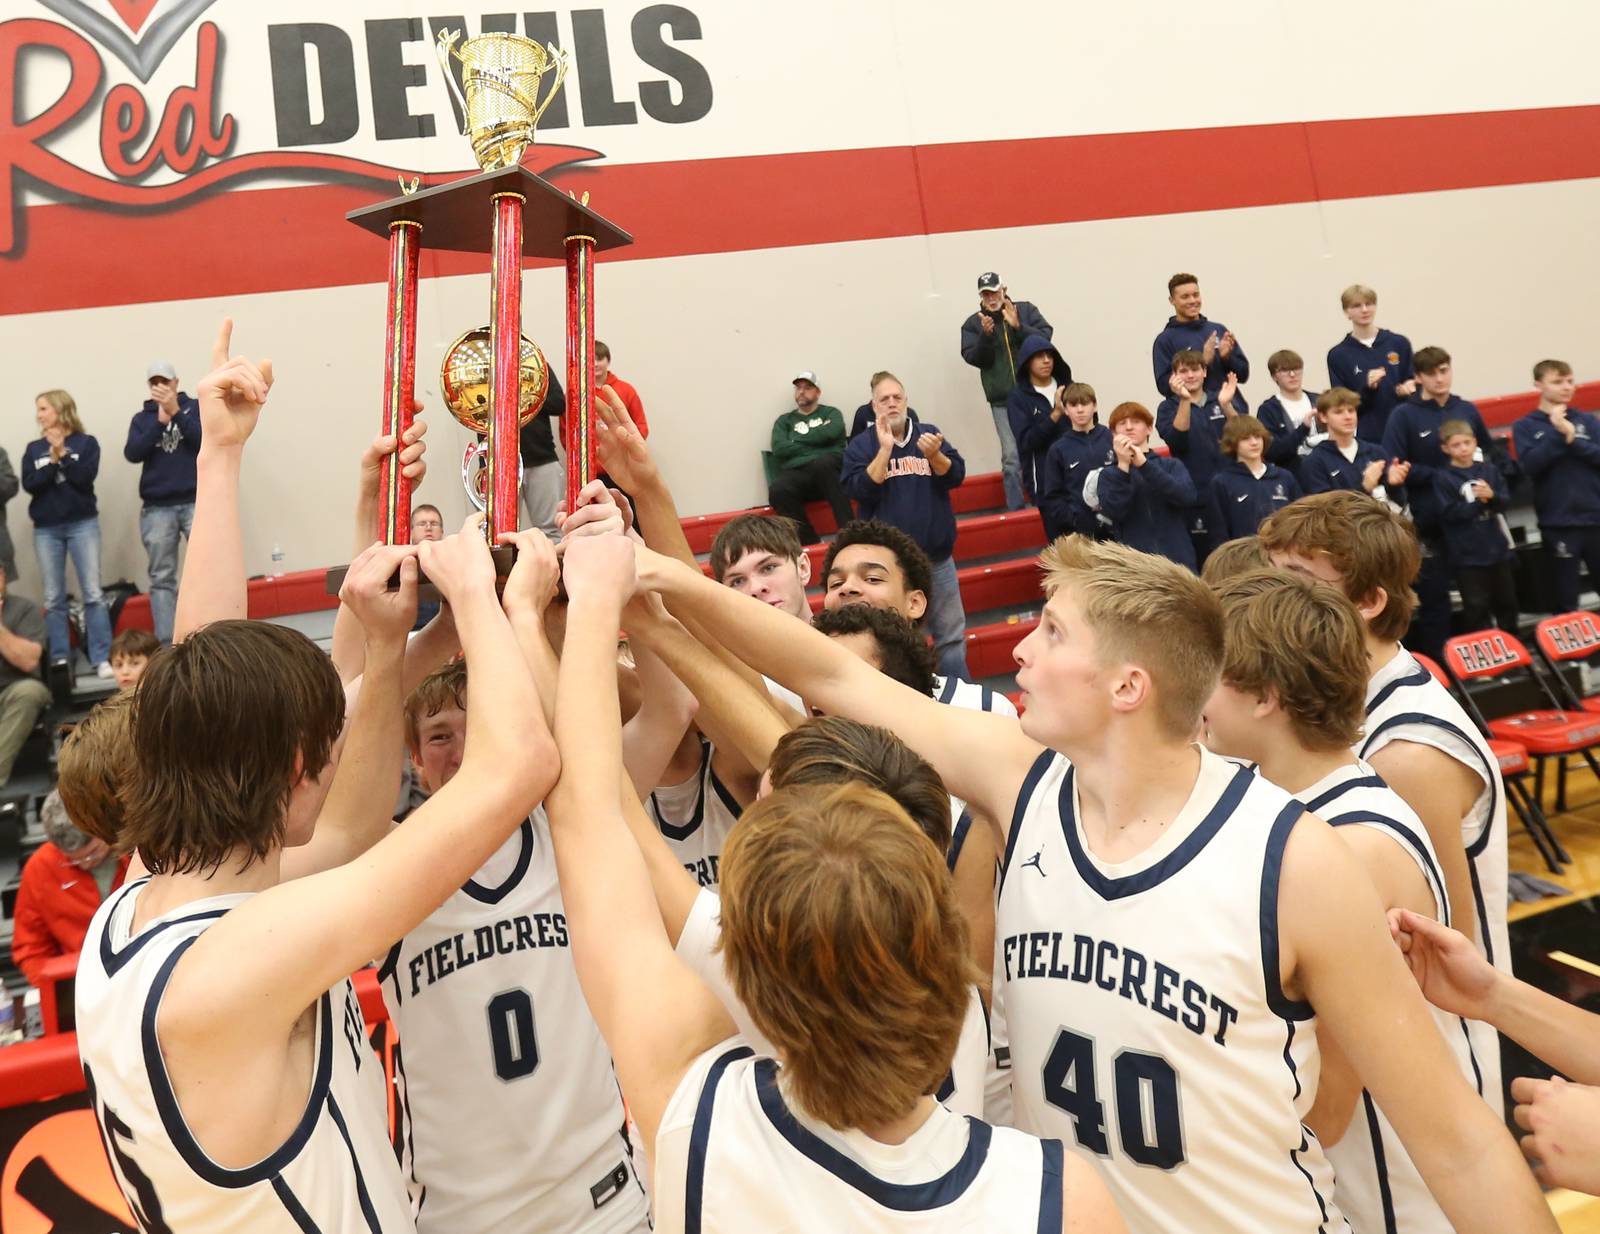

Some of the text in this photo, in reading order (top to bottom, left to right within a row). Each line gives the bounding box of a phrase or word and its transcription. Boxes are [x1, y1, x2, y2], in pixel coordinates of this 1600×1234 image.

[1456, 637, 1520, 673] HALL
[1545, 617, 1600, 655] HALL
[408, 913, 569, 997] FIELDCRES
[1004, 932, 1239, 1047] FIELDCREST
[485, 986, 541, 1085] 0
[1041, 1024, 1189, 1173] 40
